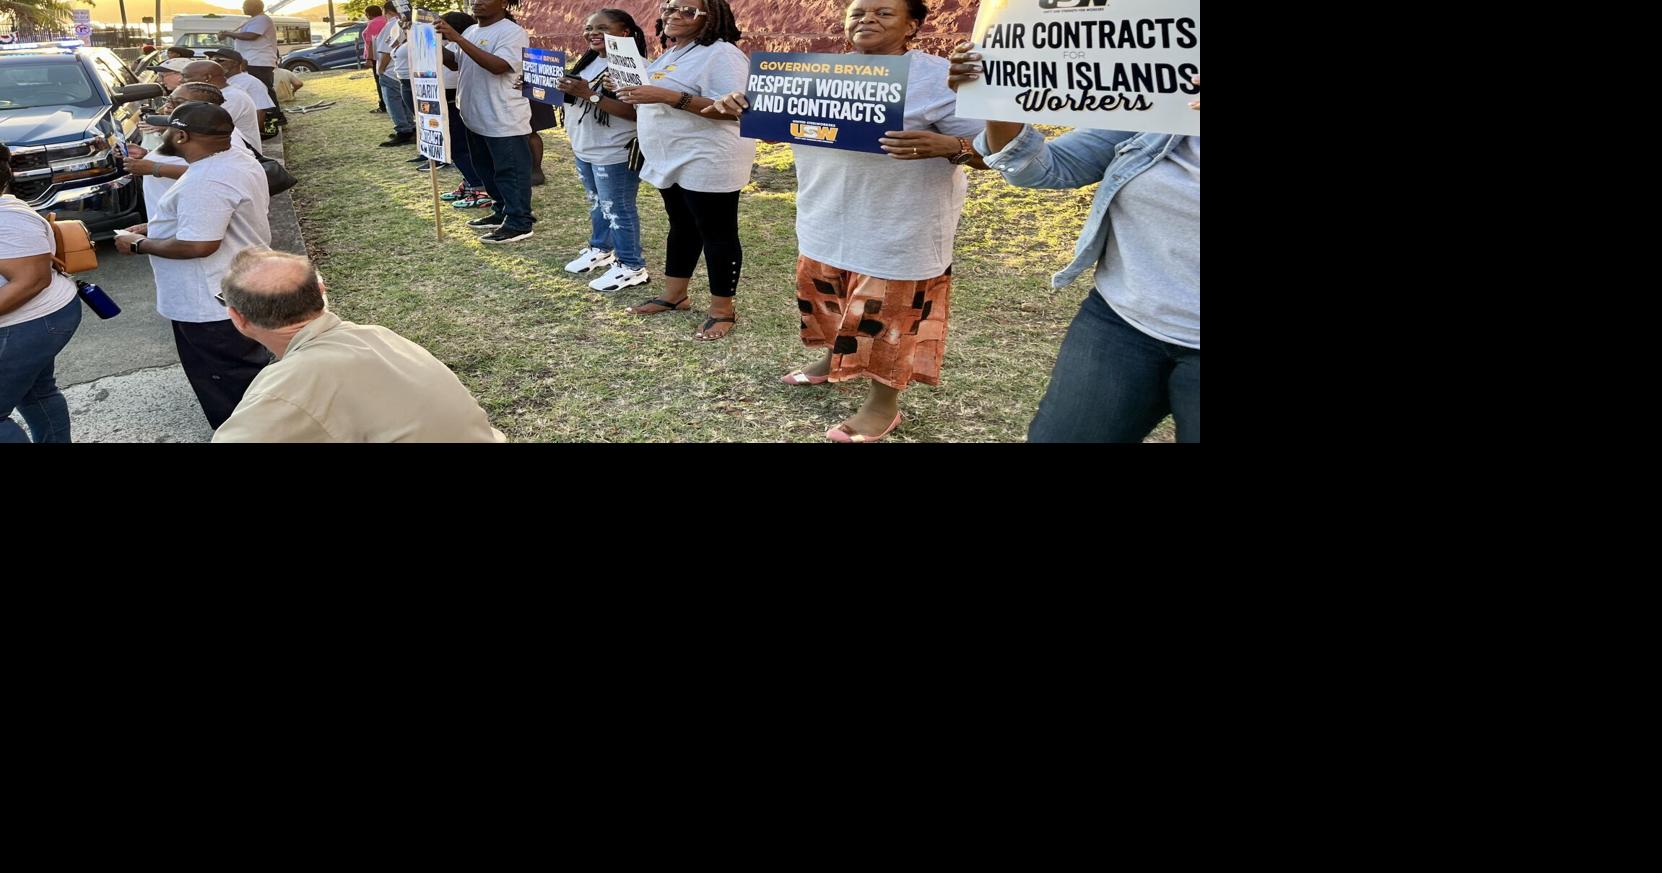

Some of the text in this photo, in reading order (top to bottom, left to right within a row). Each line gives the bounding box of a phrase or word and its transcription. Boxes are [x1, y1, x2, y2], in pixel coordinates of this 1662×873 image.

[982, 17, 1198, 49] FAIR CONTRACTS
[1063, 51, 1086, 60] FOR
[538, 63, 564, 78] WORKERS
[759, 61, 890, 76] GOVERNOR BRYAN:
[982, 60, 1200, 95] VIRGIN ISLANDS
[748, 74, 903, 104] RESPECT WORKERS
[1015, 88, 1153, 112] Workers
[753, 94, 886, 124] AND CONTRACTS
[790, 123, 839, 142] USW
